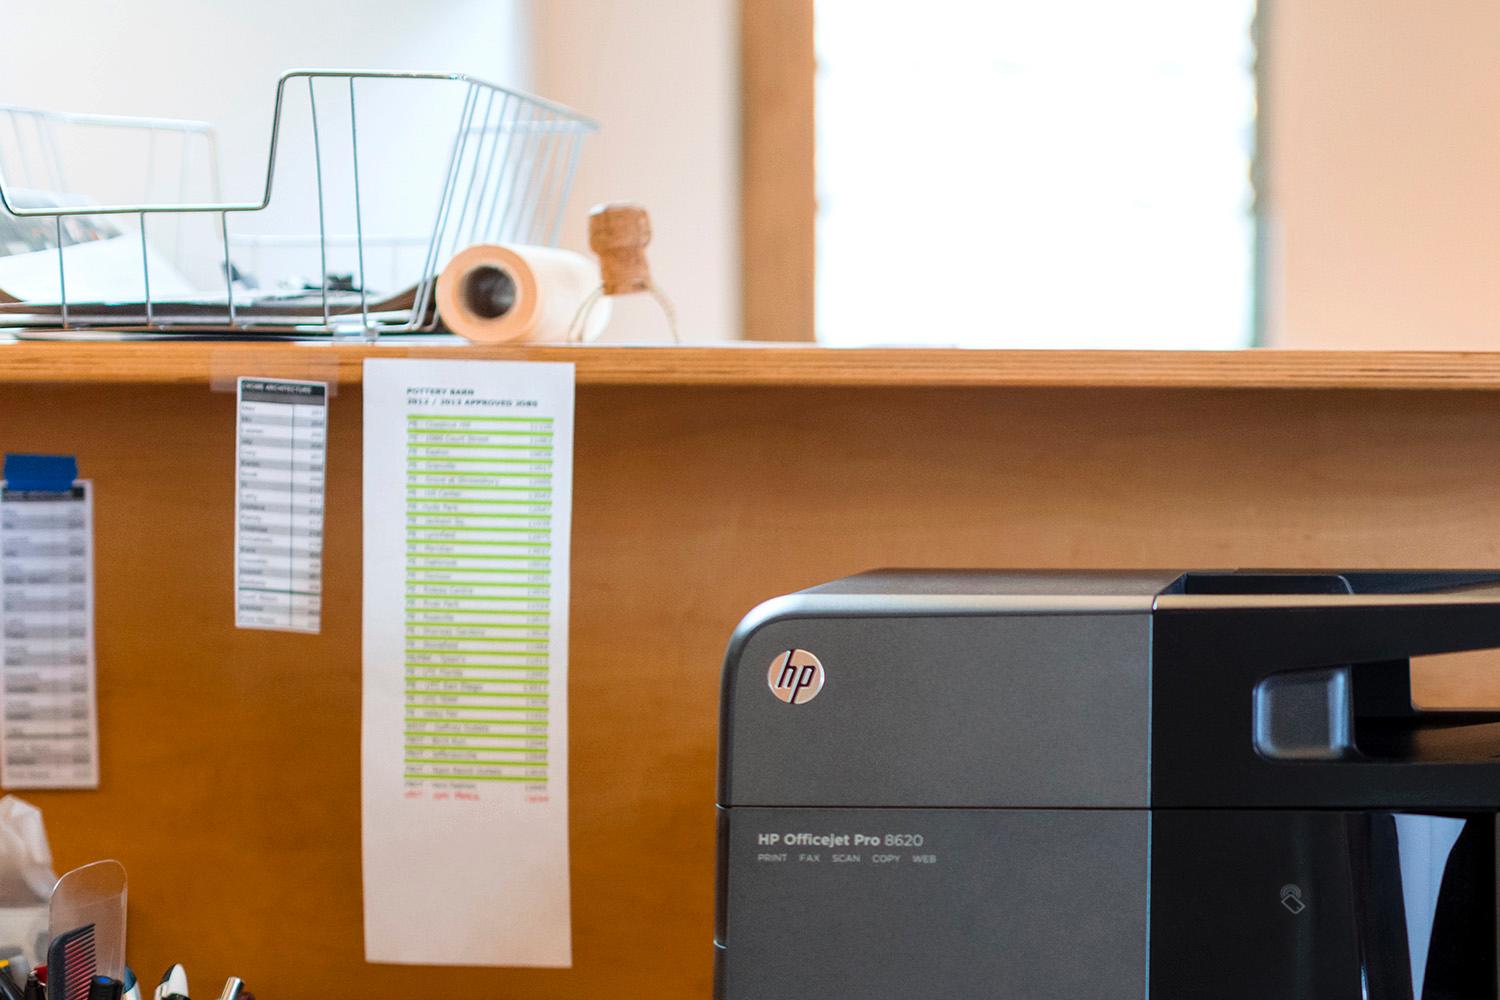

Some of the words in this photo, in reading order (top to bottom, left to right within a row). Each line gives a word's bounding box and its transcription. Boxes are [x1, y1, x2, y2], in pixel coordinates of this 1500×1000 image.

[406, 387, 447, 396] POTTERY
[449, 389, 475, 397] BARN
[464, 400, 512, 408] APPROVED
[774, 649, 817, 704] hp
[758, 833, 779, 846] HP
[783, 833, 850, 848] Officejet
[854, 834, 881, 846] Pro
[884, 834, 923, 847] 8620
[757, 853, 788, 863] PRINT
[799, 853, 821, 863] FAX
[831, 854, 861, 864] SCAN
[872, 854, 901, 864] COPY
[912, 854, 937, 864] WEB
